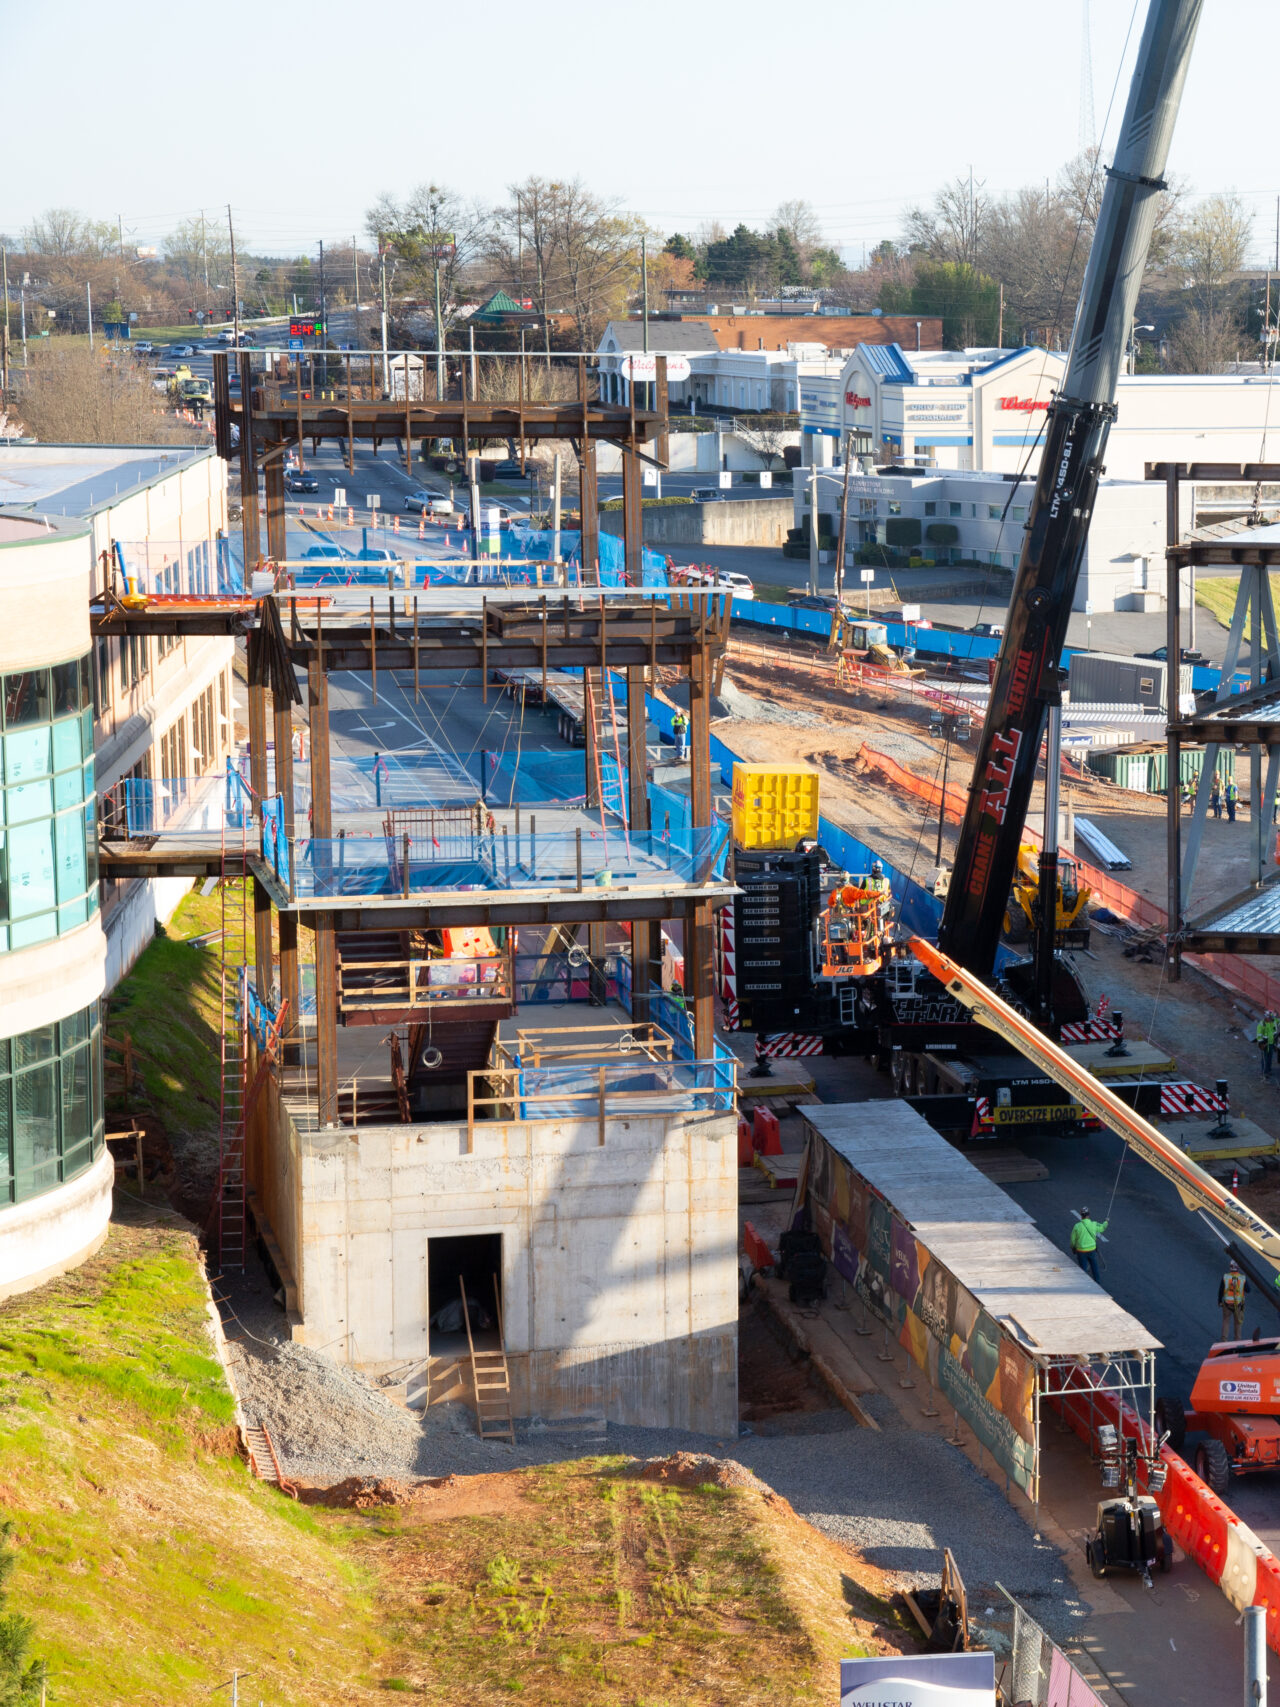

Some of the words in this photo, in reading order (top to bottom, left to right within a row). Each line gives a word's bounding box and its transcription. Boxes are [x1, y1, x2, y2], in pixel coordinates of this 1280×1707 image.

[978, 727, 1023, 825] ALL
[970, 831, 994, 896] CRANE
[835, 966, 854, 974] JLG
[1000, 1108, 1047, 1122] OVERSIZE
[1050, 1107, 1077, 1120] LOAD
